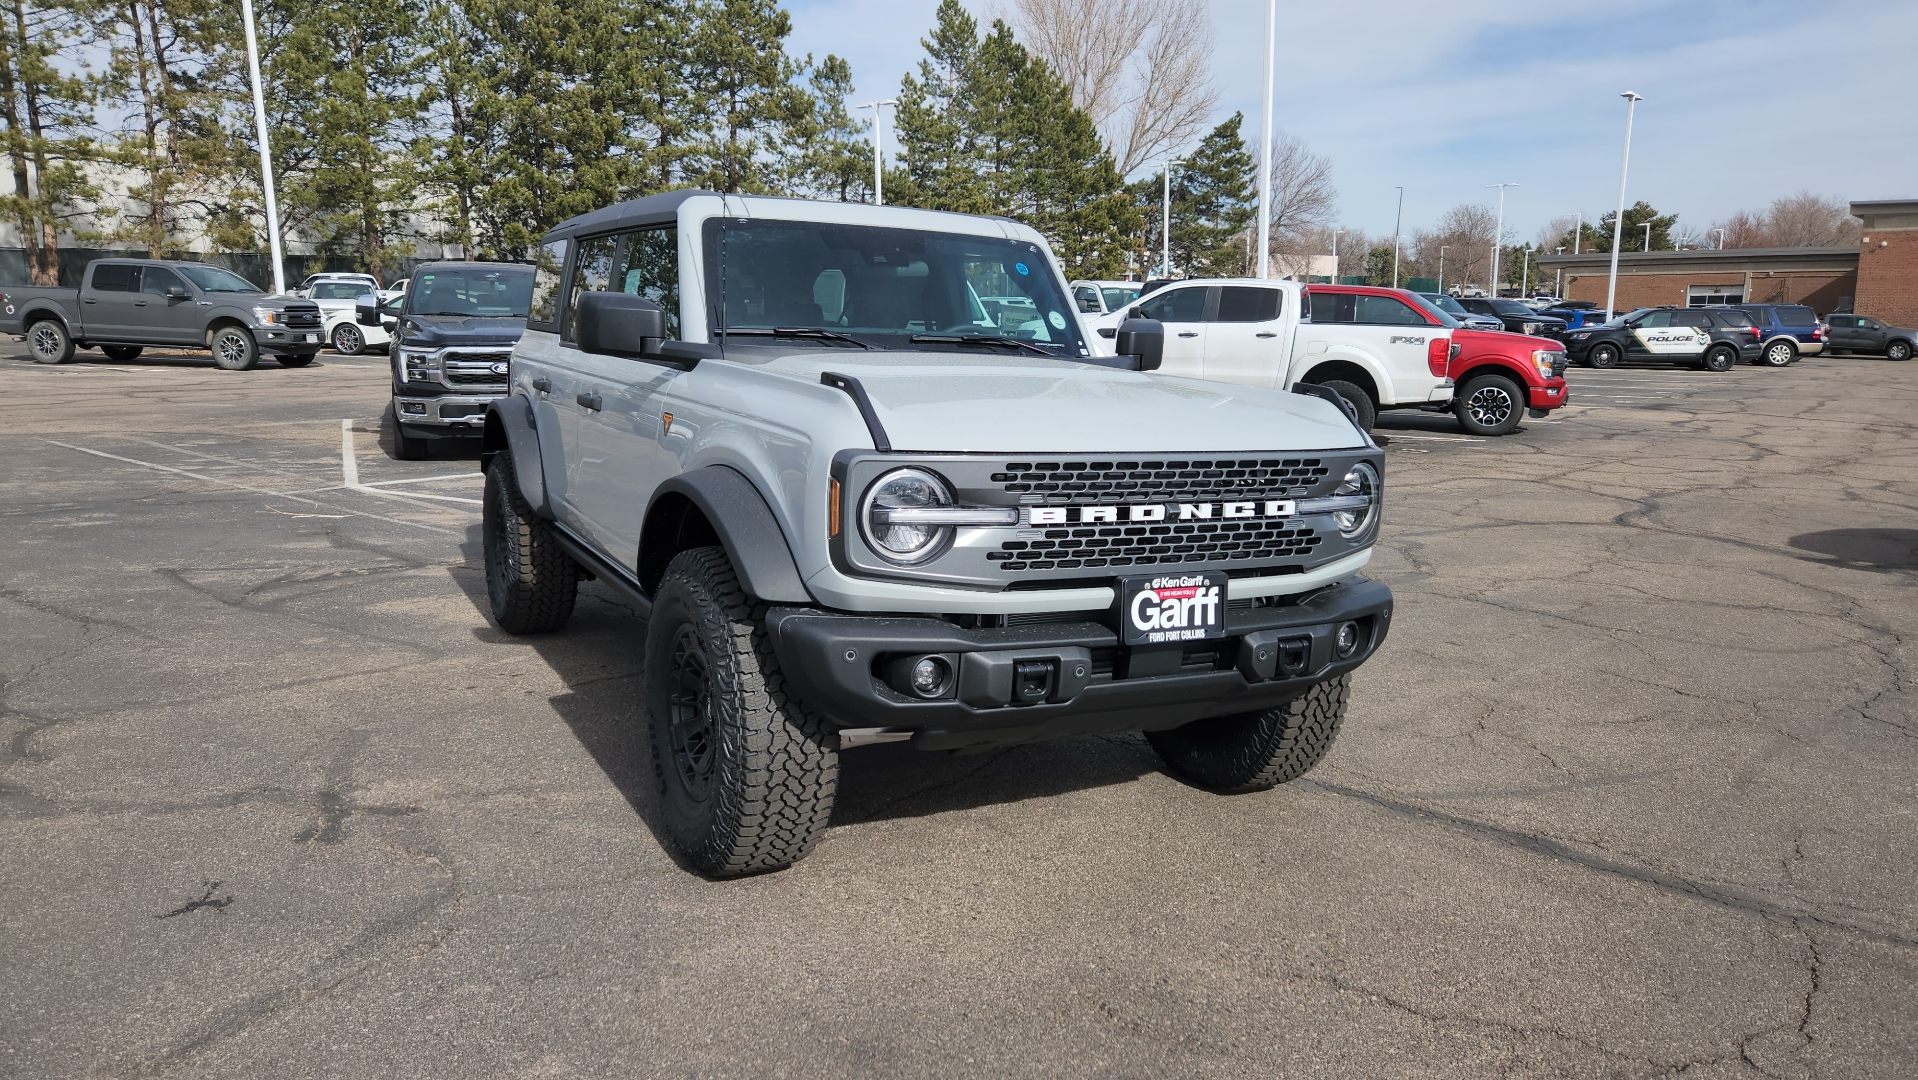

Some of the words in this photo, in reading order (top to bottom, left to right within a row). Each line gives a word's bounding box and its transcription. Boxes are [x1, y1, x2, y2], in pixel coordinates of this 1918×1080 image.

[1390, 335, 1425, 344] FX4
[1029, 500, 1296, 525] BRONCO
[1160, 577, 1179, 588] Ken
[1180, 575, 1203, 587] Garff
[1131, 587, 1219, 631] Garff
[1149, 632, 1165, 642] FORD
[1165, 630, 1180, 641] FORT
[1180, 628, 1205, 640] COLLINS
